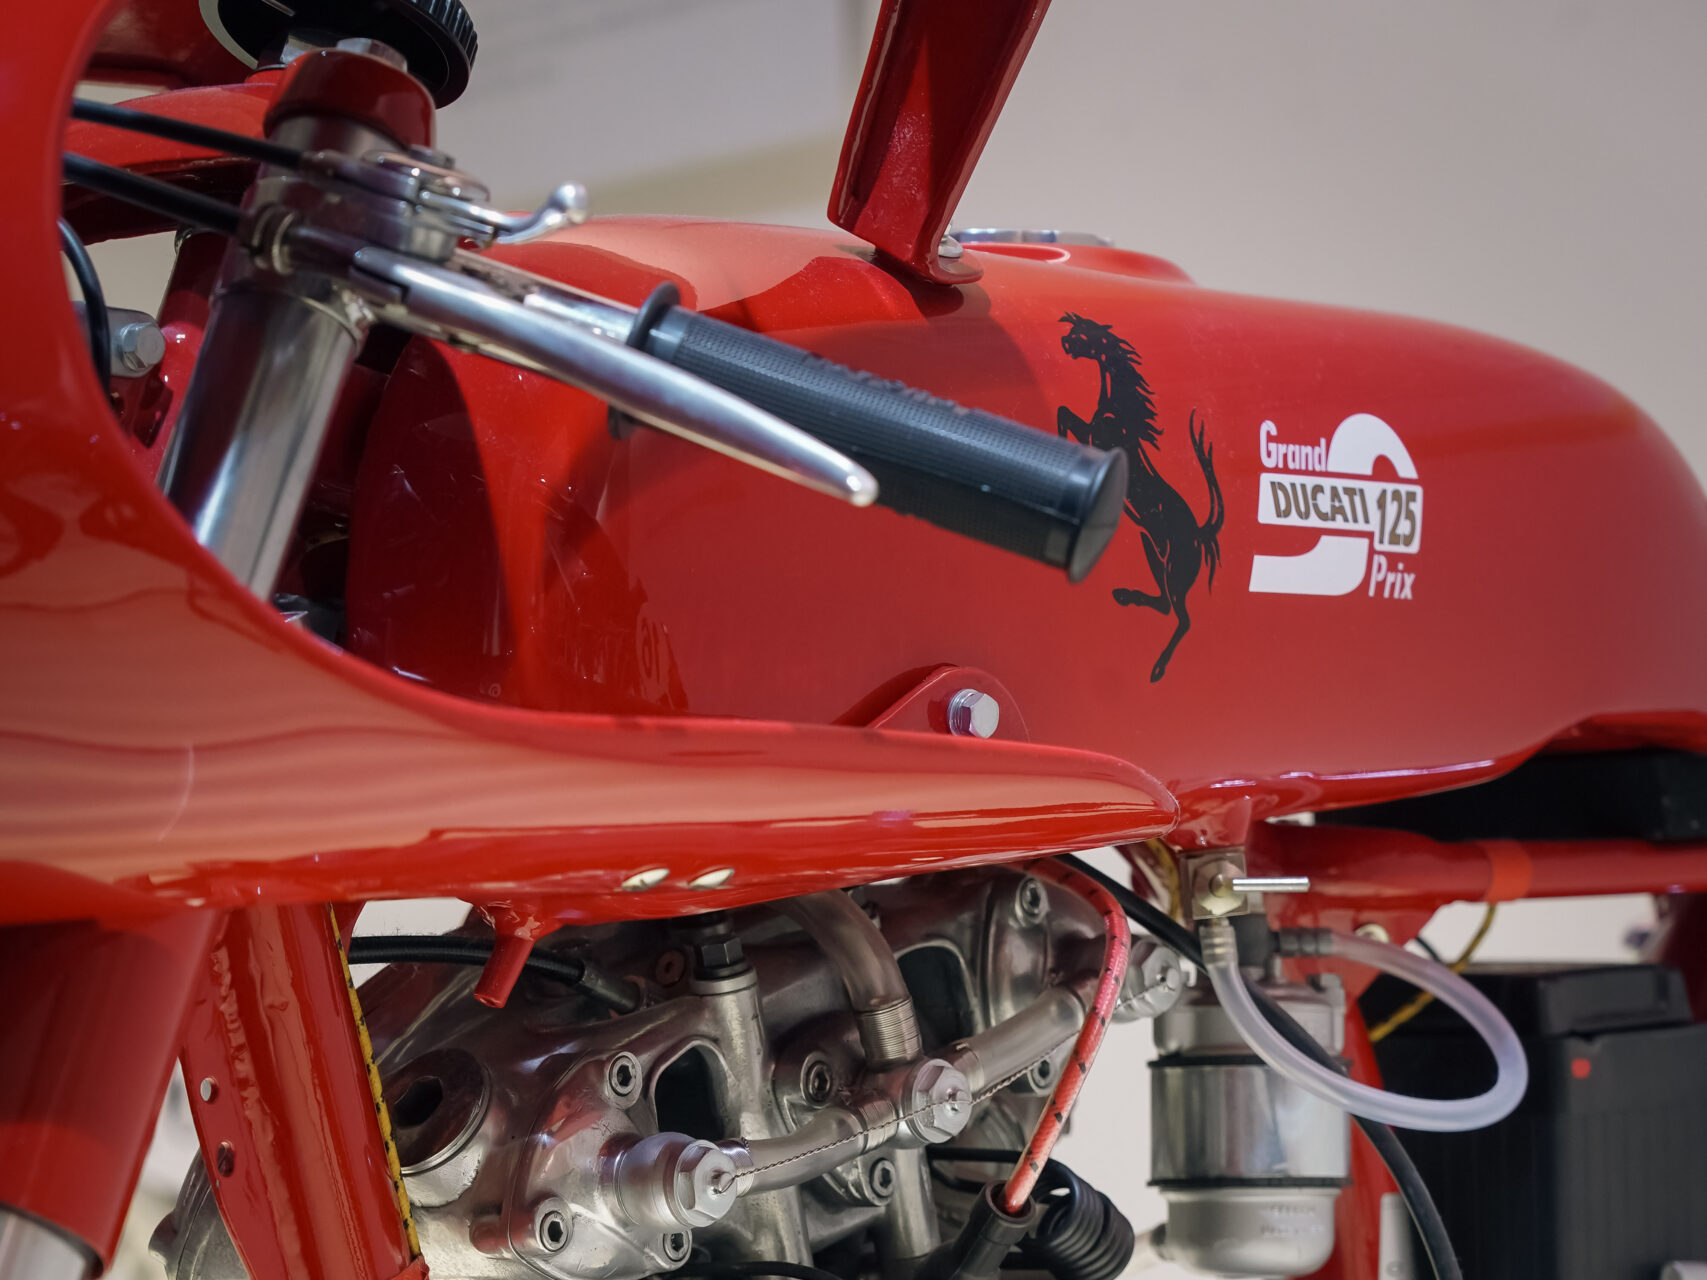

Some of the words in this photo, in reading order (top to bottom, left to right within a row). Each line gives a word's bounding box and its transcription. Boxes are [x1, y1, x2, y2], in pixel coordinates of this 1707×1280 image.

[1259, 420, 1327, 472] Grand
[1269, 481, 1370, 524] DUCATI
[1376, 488, 1417, 547] 125
[1368, 554, 1416, 600] Prix
